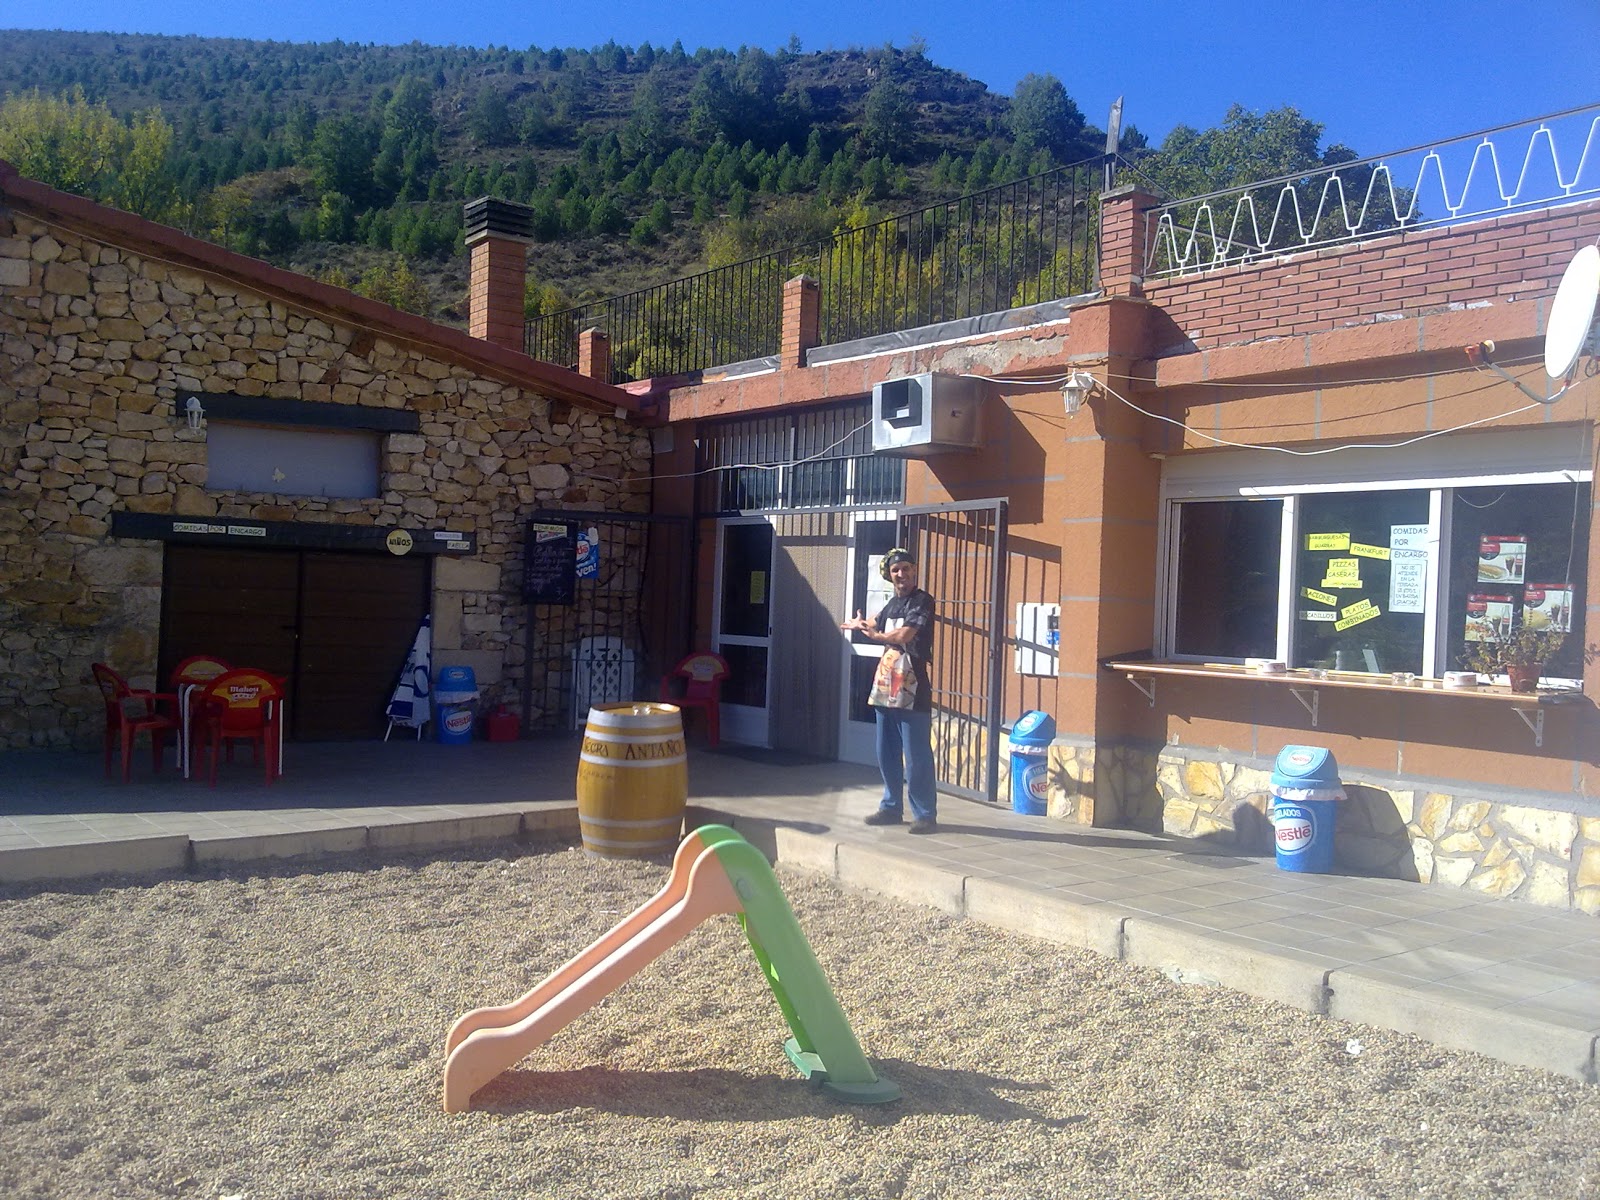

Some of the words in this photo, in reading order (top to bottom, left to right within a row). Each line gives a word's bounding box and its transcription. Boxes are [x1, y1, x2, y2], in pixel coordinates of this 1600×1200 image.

[173, 524, 208, 532] COMIDAS
[210, 525, 224, 533] POR
[230, 527, 263, 535] ENCARGO
[1392, 527, 1429, 535] COMIDAS
[1394, 538, 1409, 546] POR
[1353, 545, 1388, 556] FRANKFURT
[1394, 550, 1429, 558] ENCARGO
[1345, 601, 1370, 615] PLATOS
[1337, 608, 1379, 630] COMBINADOS
[625, 739, 682, 761] ANTAÑO
